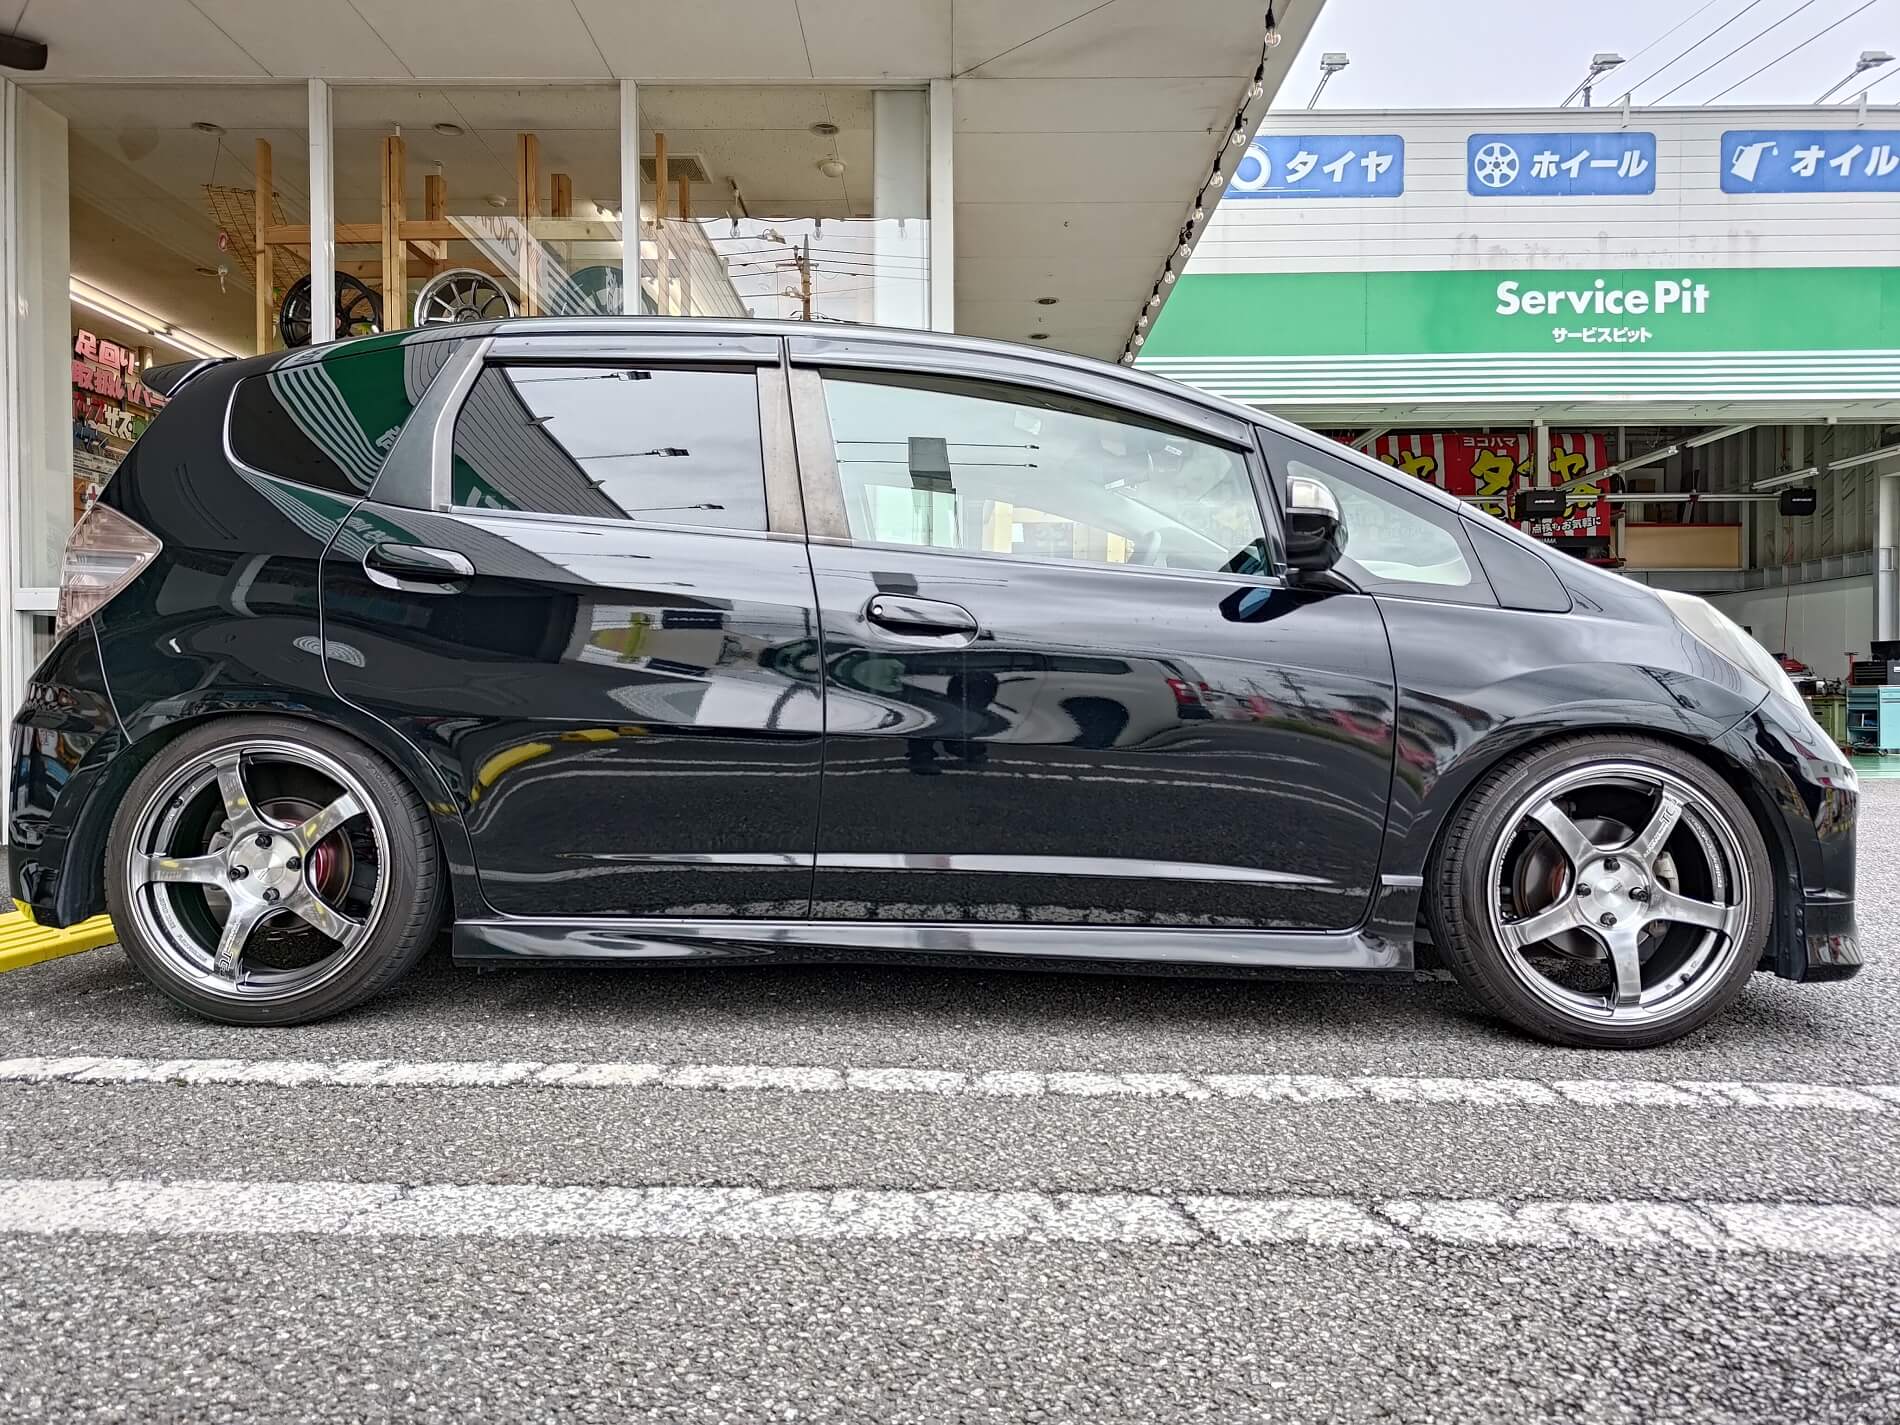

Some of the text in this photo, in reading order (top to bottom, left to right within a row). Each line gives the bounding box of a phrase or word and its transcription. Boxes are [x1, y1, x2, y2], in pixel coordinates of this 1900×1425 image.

[1285, 150, 1393, 183] タイヤ
[1530, 150, 1649, 178] ホイール
[1790, 144, 1900, 177] オイル
[1496, 278, 1710, 315] Service Pit
[1552, 327, 1653, 343] サービスピット
[75, 328, 135, 376] 足回り
[1463, 437, 1517, 447] ヨコハマ
